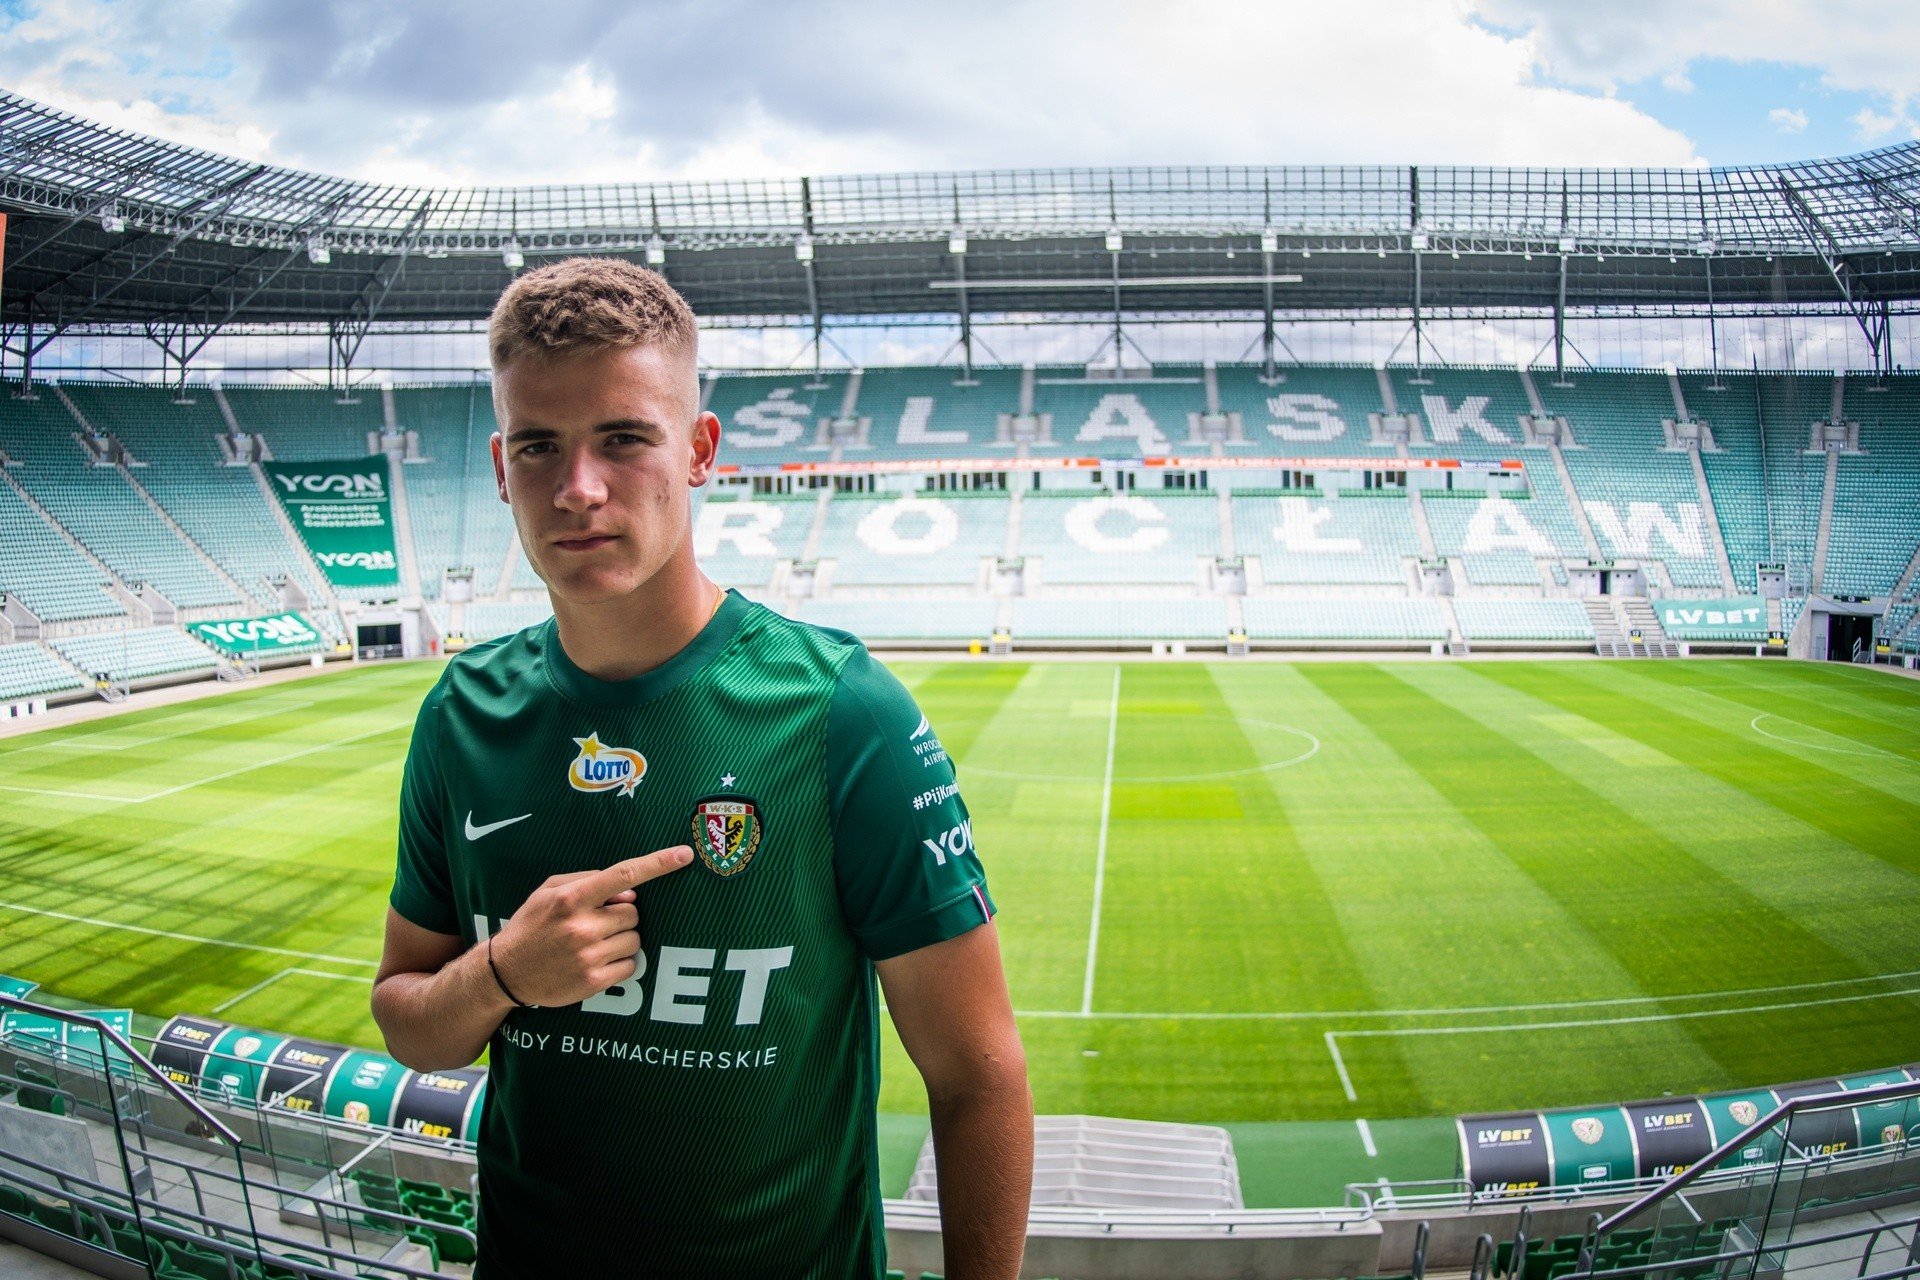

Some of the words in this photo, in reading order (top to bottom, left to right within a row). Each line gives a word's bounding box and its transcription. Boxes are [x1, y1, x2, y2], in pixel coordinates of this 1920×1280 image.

[698, 495, 1709, 560] ROCŁAW
[584, 758, 631, 781] LOTTO
[561, 1035, 778, 1069] BUKMACHERSKIE
